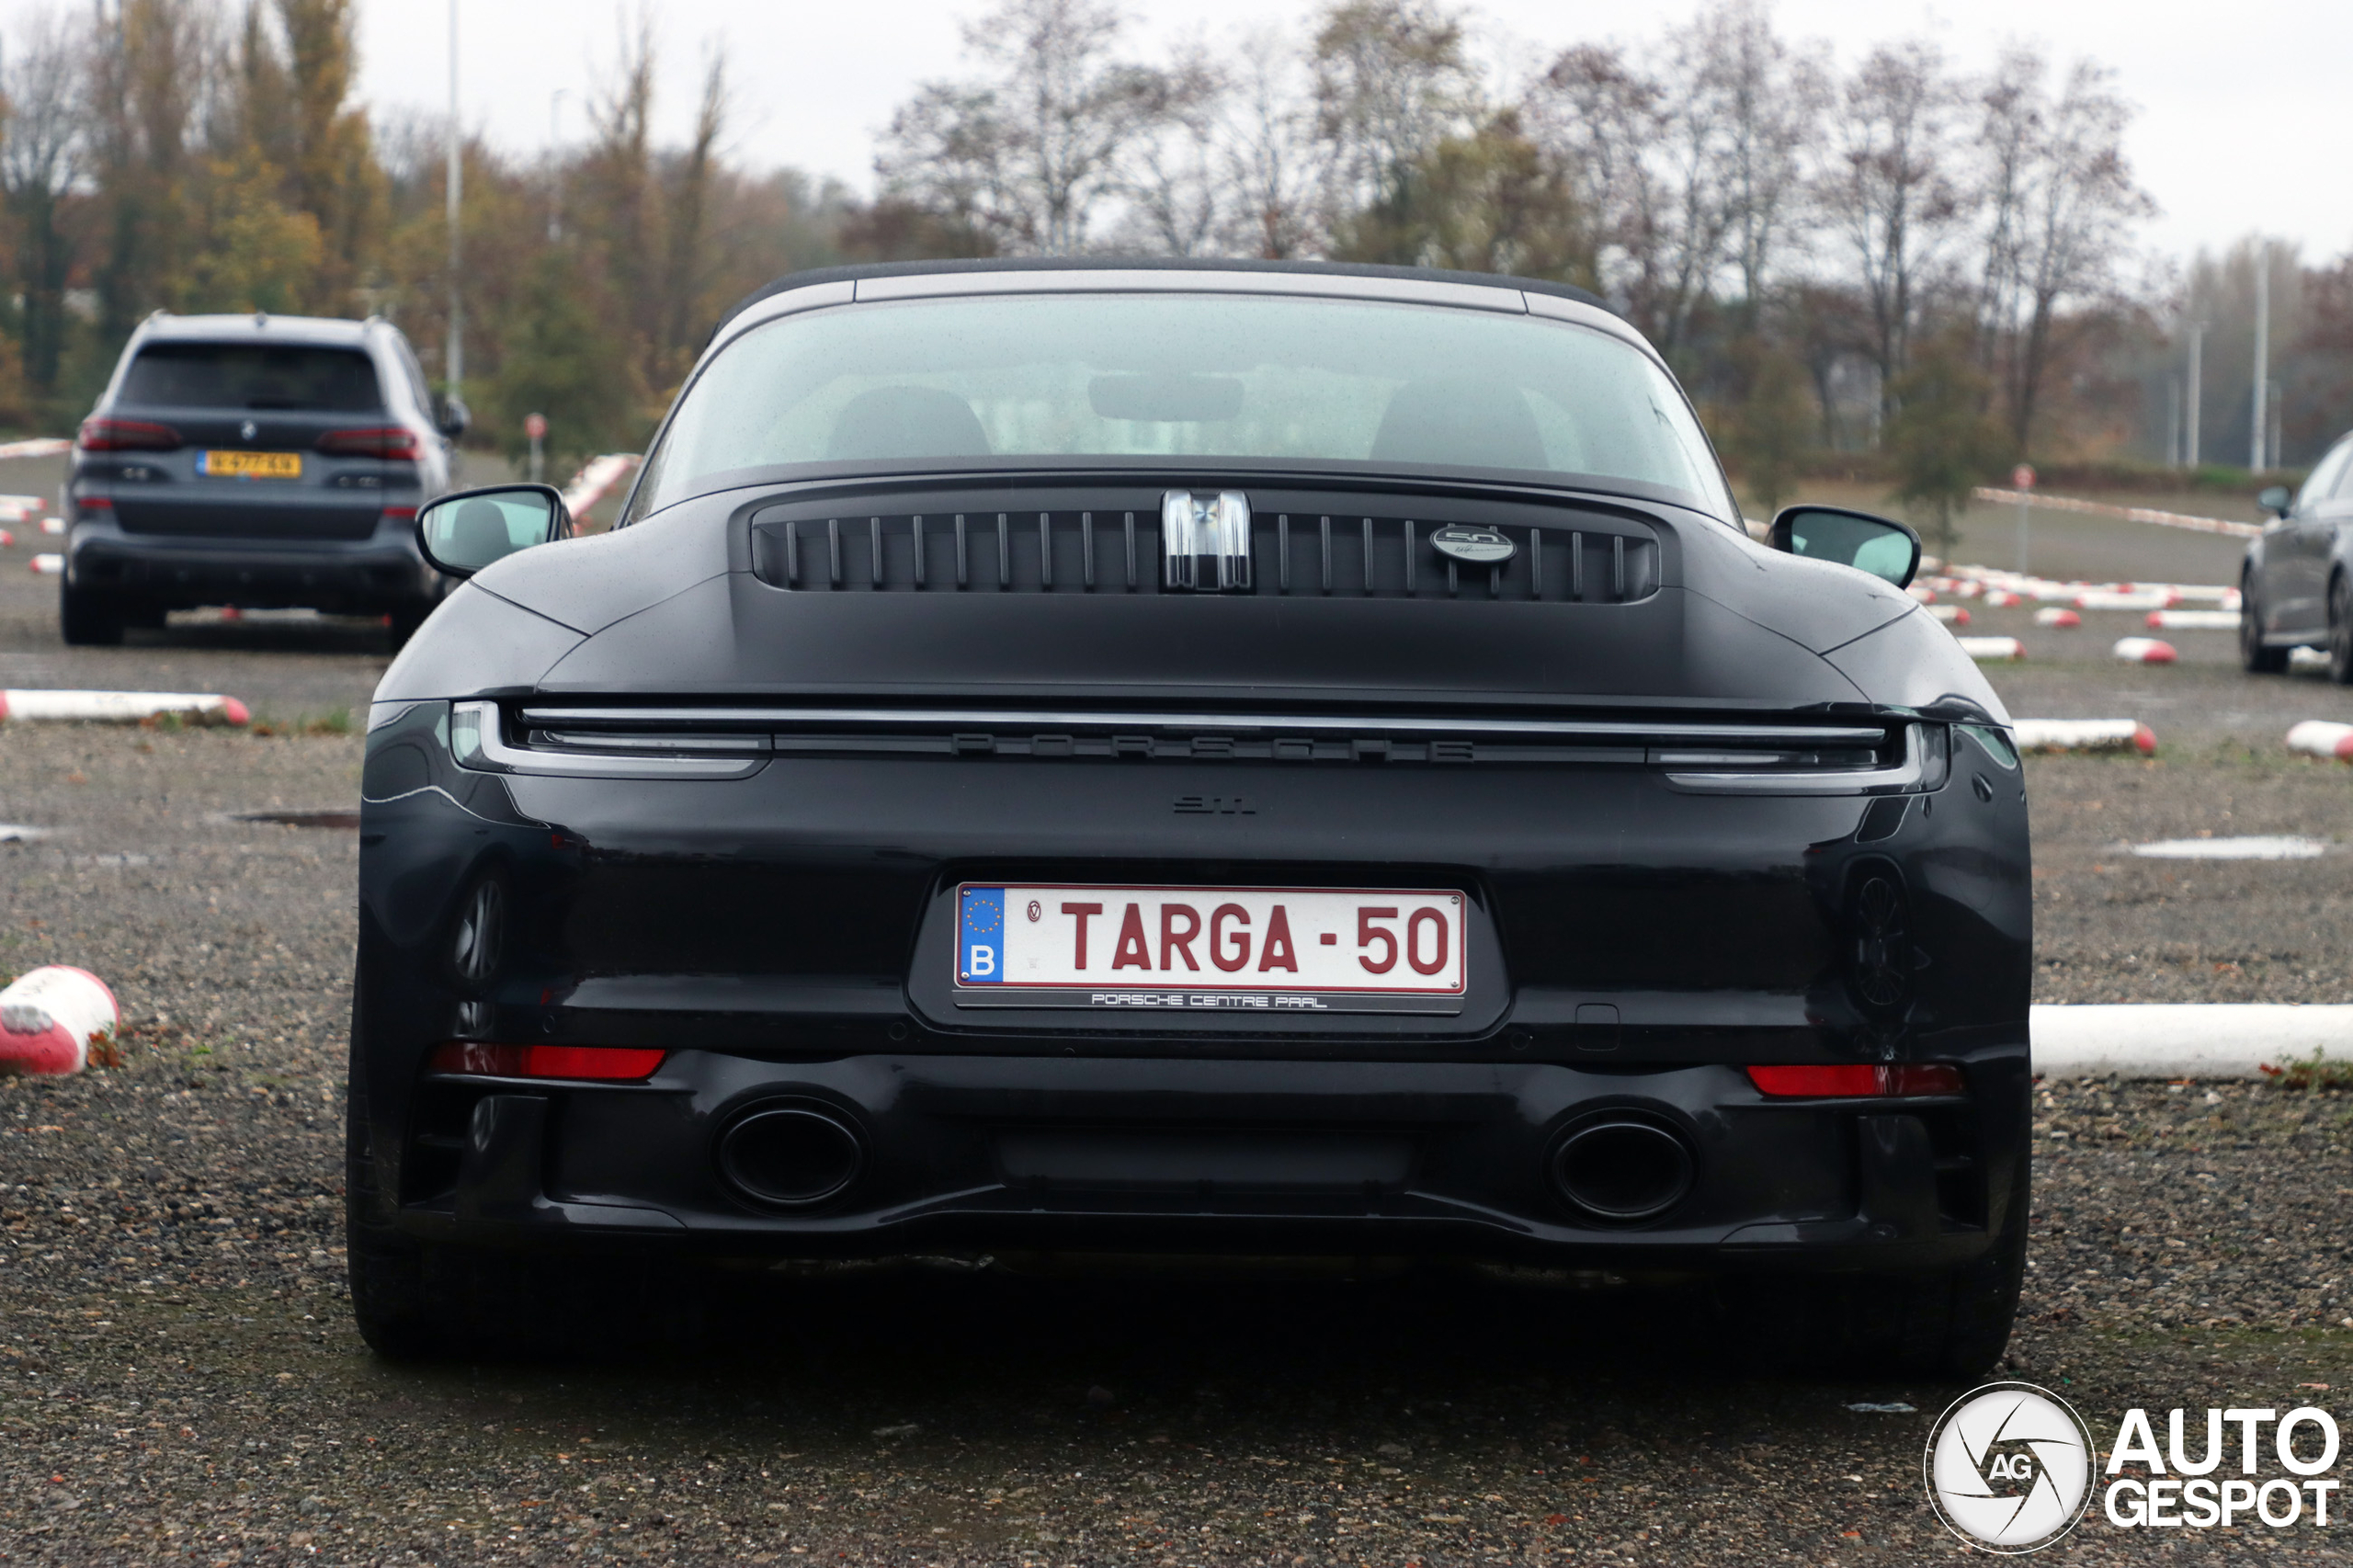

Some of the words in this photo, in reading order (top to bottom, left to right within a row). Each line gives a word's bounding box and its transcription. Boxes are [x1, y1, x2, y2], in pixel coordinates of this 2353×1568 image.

[950, 733, 1474, 763] PORSCHE
[971, 945, 995, 975] B
[1091, 994, 1184, 1006] PORSCHE
[1189, 994, 1269, 1007] CENTRE
